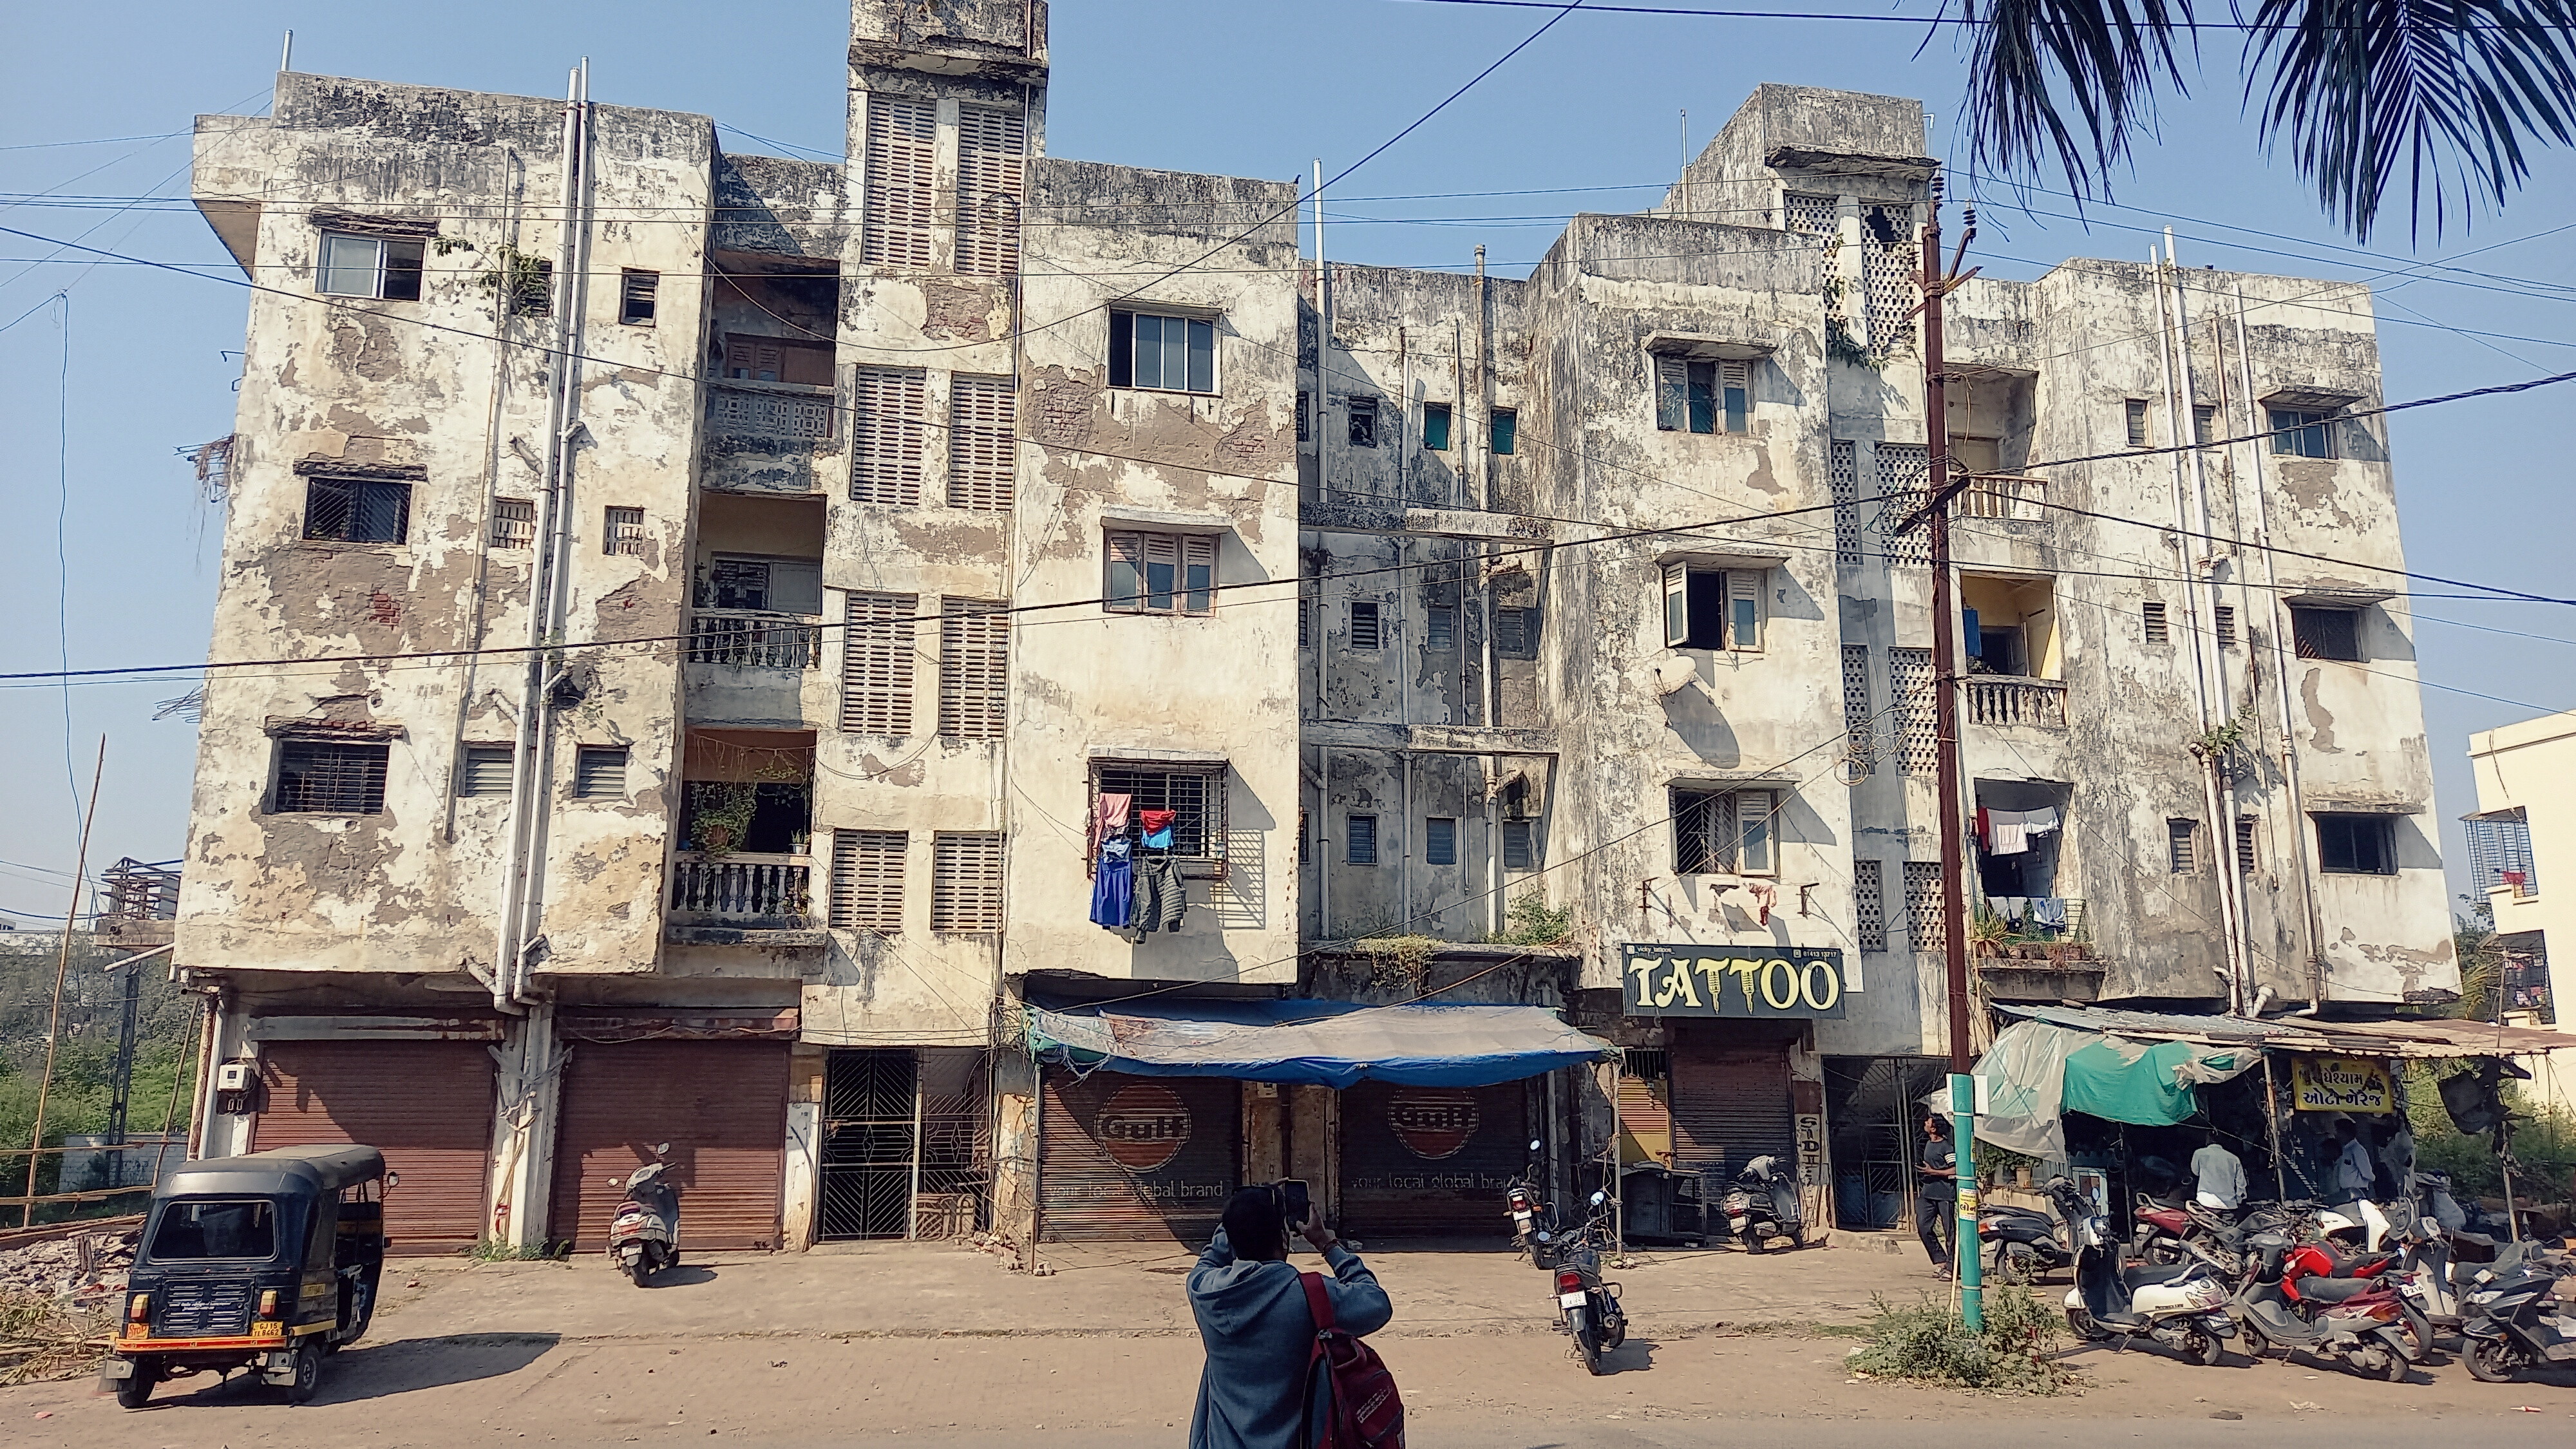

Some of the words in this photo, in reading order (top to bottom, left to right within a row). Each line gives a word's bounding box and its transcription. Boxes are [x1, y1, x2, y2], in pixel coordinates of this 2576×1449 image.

[1628, 956, 1840, 1015] TATTOO
[1394, 1104, 1473, 1128] Gulf
[1101, 1115, 1185, 1139] Gulf
[1088, 1181, 1124, 1198] local
[1132, 1180, 1175, 1200] global
[1181, 1180, 1223, 1197] brand
[1388, 1172, 1425, 1189] local
[1431, 1172, 1475, 1190] global
[2404, 1285, 2423, 1295] 7216
[128, 1324, 147, 1338] STOP
